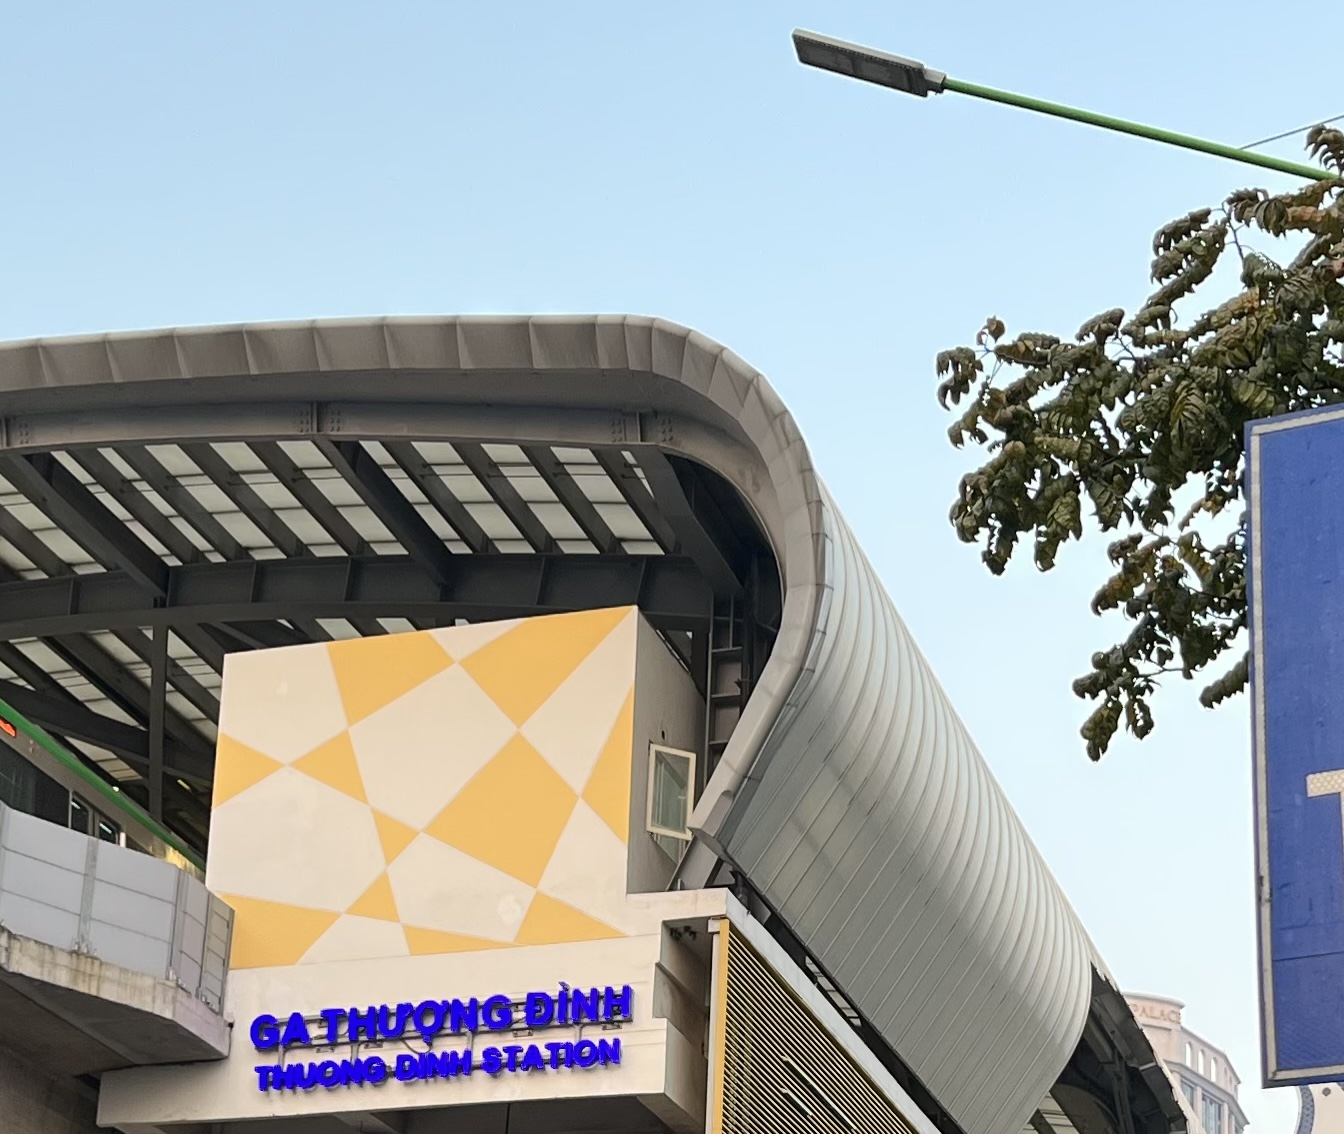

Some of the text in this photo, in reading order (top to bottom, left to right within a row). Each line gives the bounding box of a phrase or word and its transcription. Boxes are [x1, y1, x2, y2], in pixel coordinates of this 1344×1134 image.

[249, 981, 633, 1050] GA THƯỢNG ĐÌNH
[254, 1037, 622, 1092] THUONG DINH STATION
